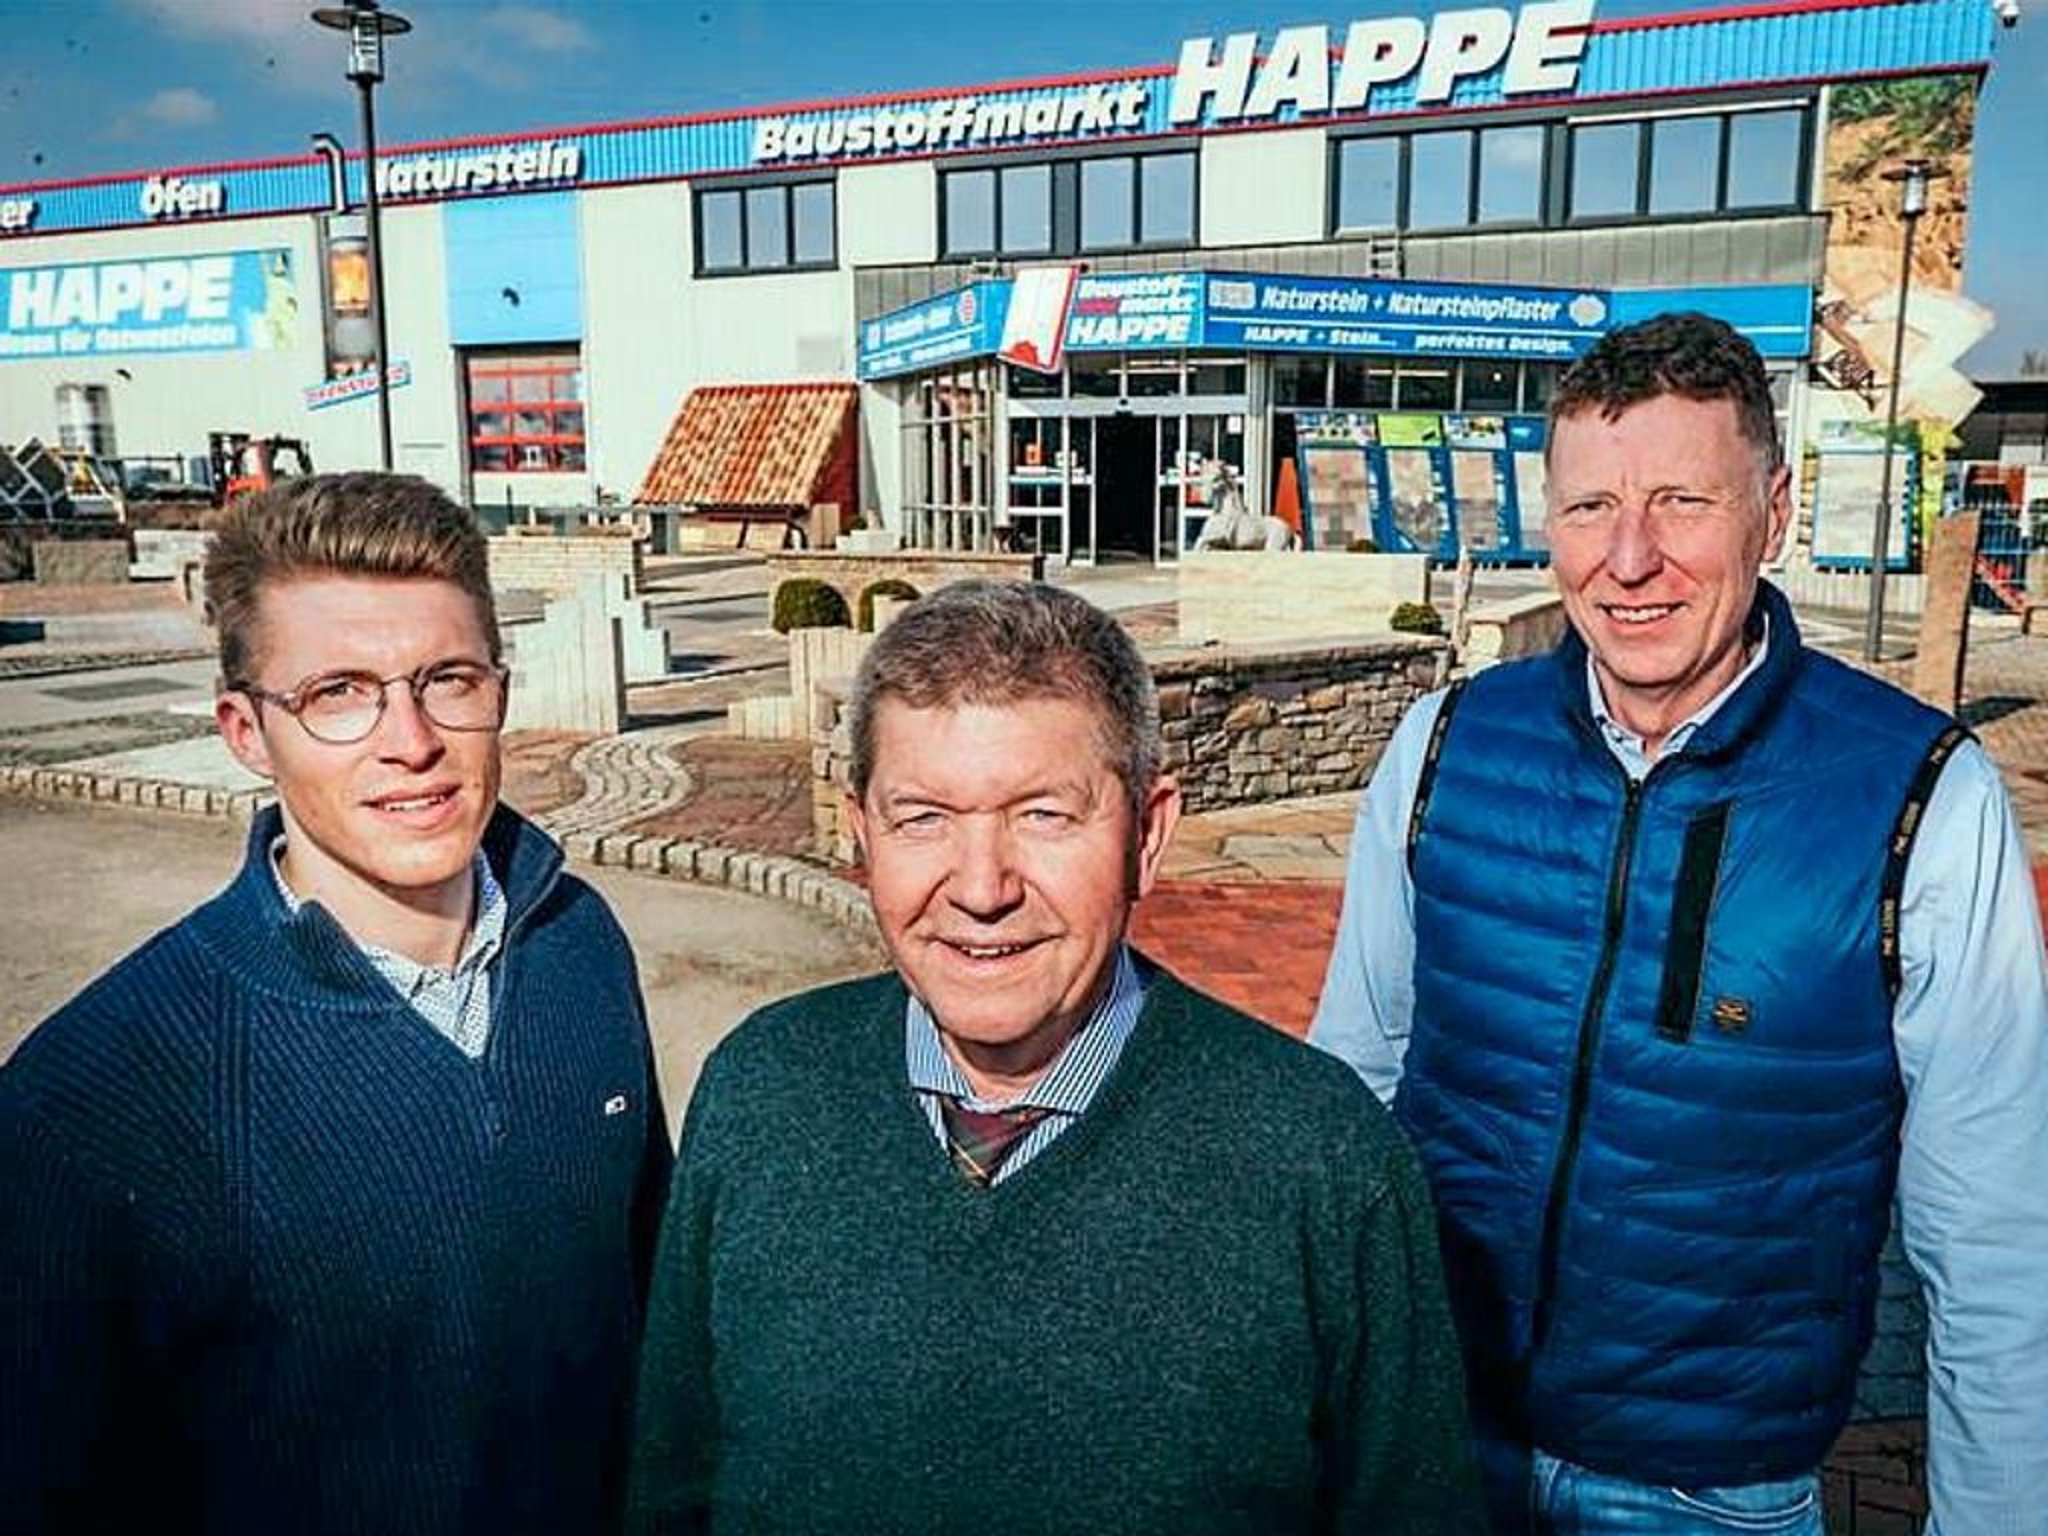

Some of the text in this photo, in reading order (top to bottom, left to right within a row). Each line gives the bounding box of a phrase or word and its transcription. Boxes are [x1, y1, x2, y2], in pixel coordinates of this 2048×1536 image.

[754, 0, 1597, 161] Baustoffmarkt HAPPE
[140, 175, 222, 217] Öfen
[9, 256, 235, 328] HAPPE
[1261, 285, 1369, 314] Naturstein
[1387, 291, 1563, 321] Natursteinpflaster
[1068, 313, 1192, 345] HAPPE
[1244, 326, 1310, 344] HAPPE
